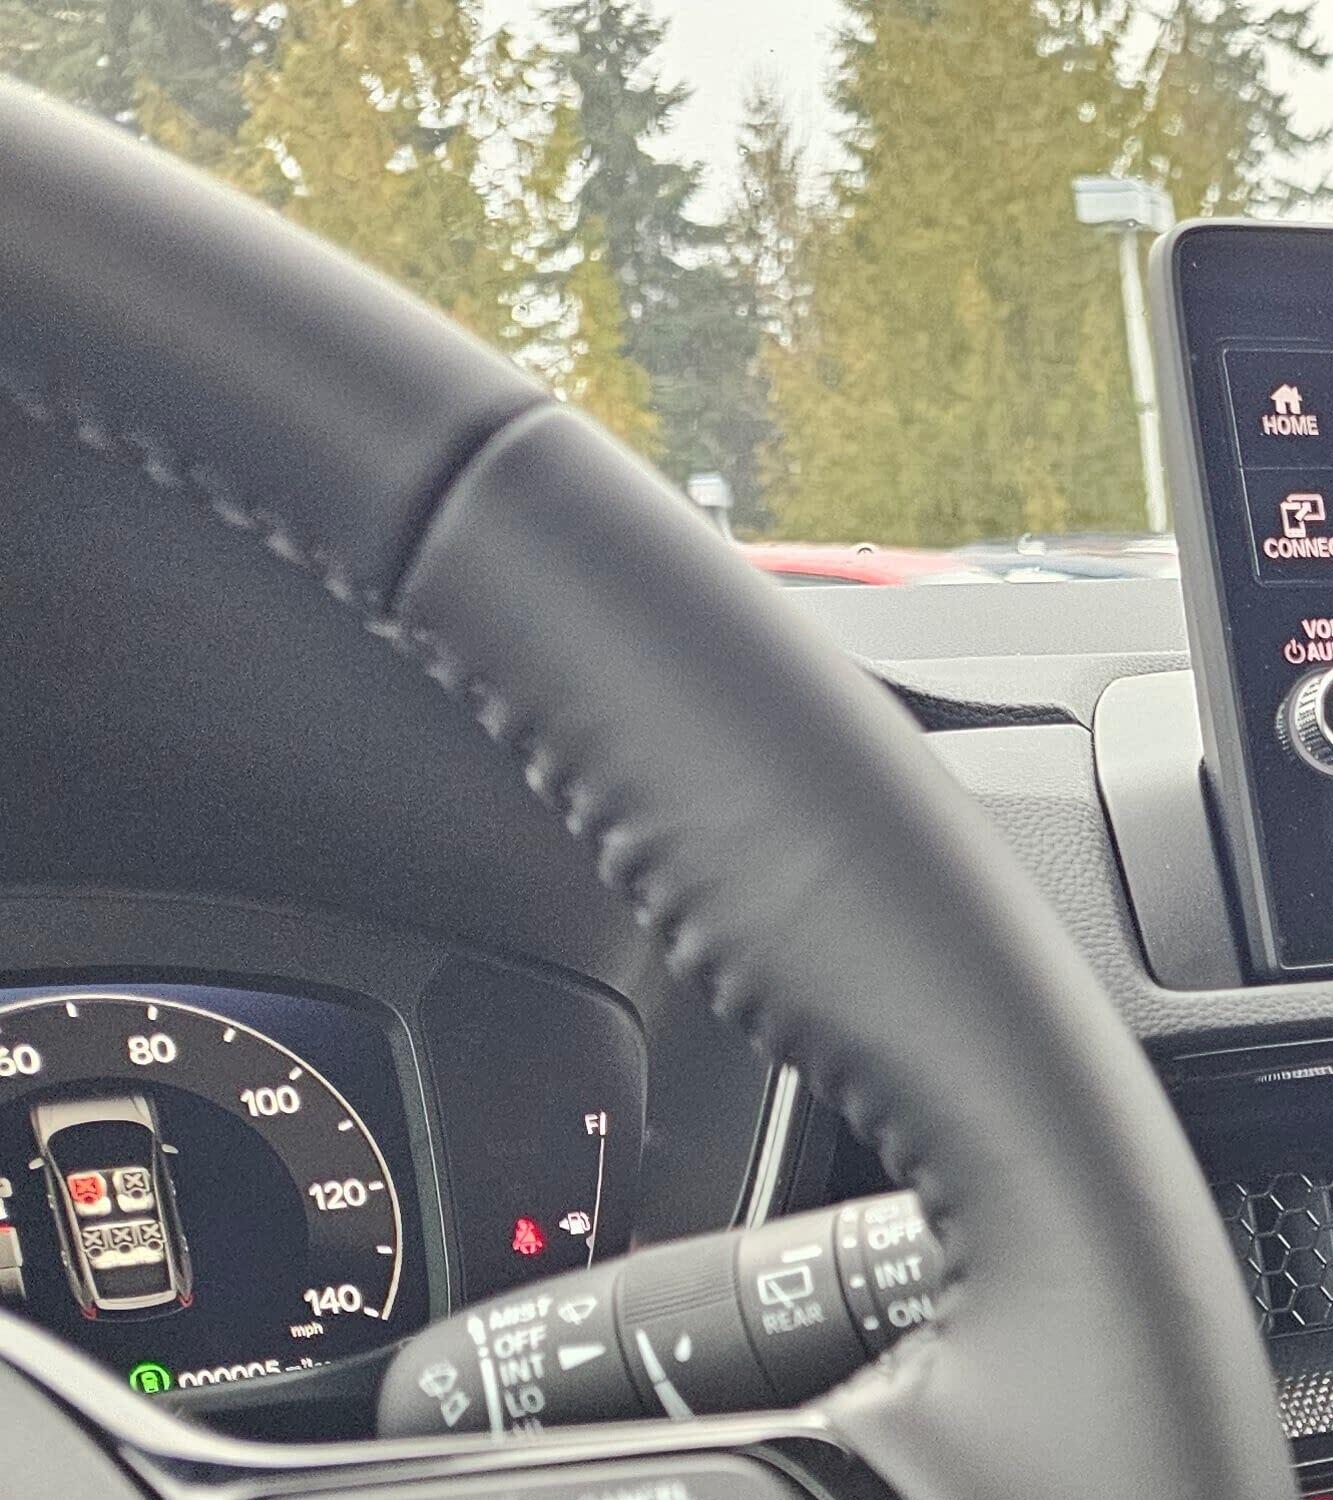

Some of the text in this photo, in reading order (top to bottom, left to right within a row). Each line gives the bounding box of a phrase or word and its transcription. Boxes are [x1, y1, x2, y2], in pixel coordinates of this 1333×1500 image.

[1262, 415, 1319, 436] HOME
[127, 1032, 177, 1066] 80
[240, 1085, 301, 1117] 100
[308, 1180, 366, 1211] 120
[875, 1257, 922, 1289] INT
[303, 1284, 363, 1317] 140
[290, 1322, 324, 1339] mph
[763, 1305, 825, 1336] REAR
[495, 1325, 546, 1359] OFF
[500, 1353, 545, 1387] INT
[503, 1384, 546, 1419] LO
